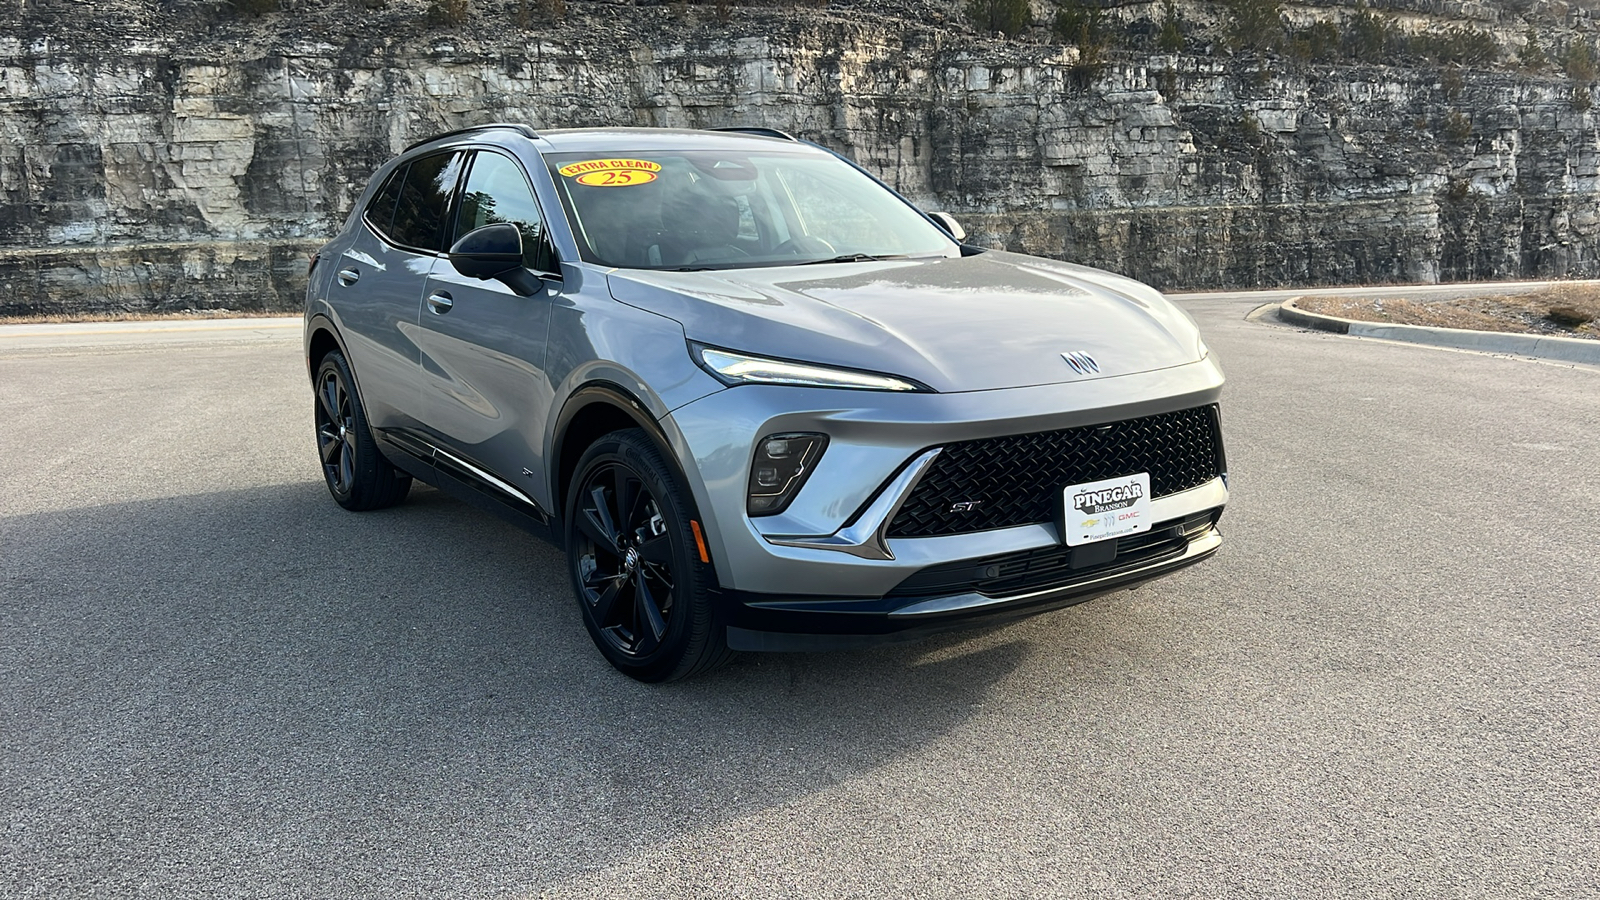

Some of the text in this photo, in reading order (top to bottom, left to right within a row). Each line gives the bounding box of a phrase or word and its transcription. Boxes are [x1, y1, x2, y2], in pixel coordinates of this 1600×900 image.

[566, 160, 653, 174] EXTRA CLEAN
[601, 170, 632, 185] 25
[1074, 484, 1143, 510] PINEGAR
[949, 500, 981, 513] ST
[1118, 511, 1140, 521] GMC
